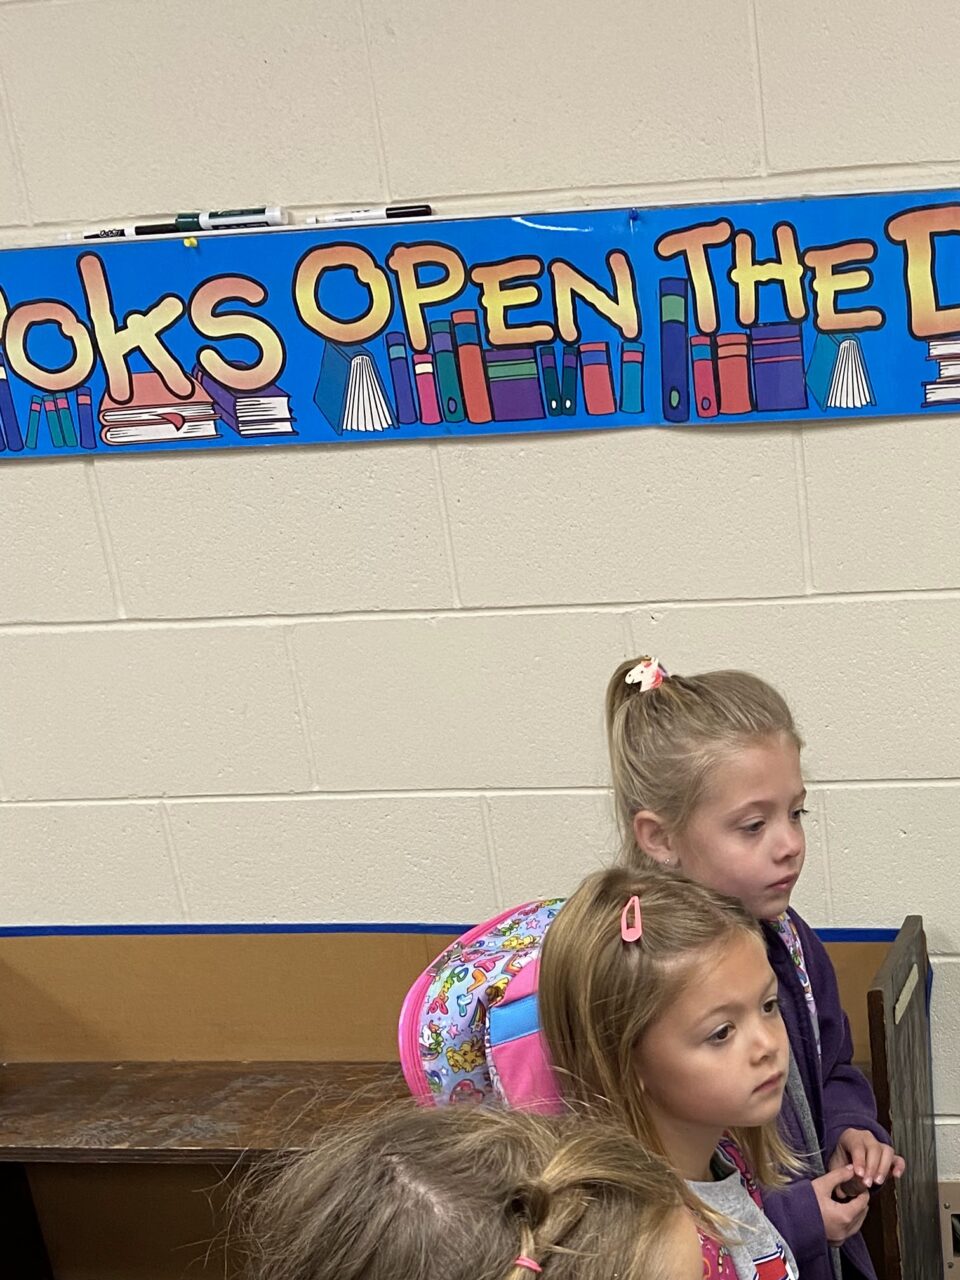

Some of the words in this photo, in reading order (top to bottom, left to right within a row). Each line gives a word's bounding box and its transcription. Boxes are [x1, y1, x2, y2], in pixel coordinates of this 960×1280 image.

[0, 251, 287, 392] oks
[294, 242, 641, 353] OPEN
[655, 218, 883, 334] THE
